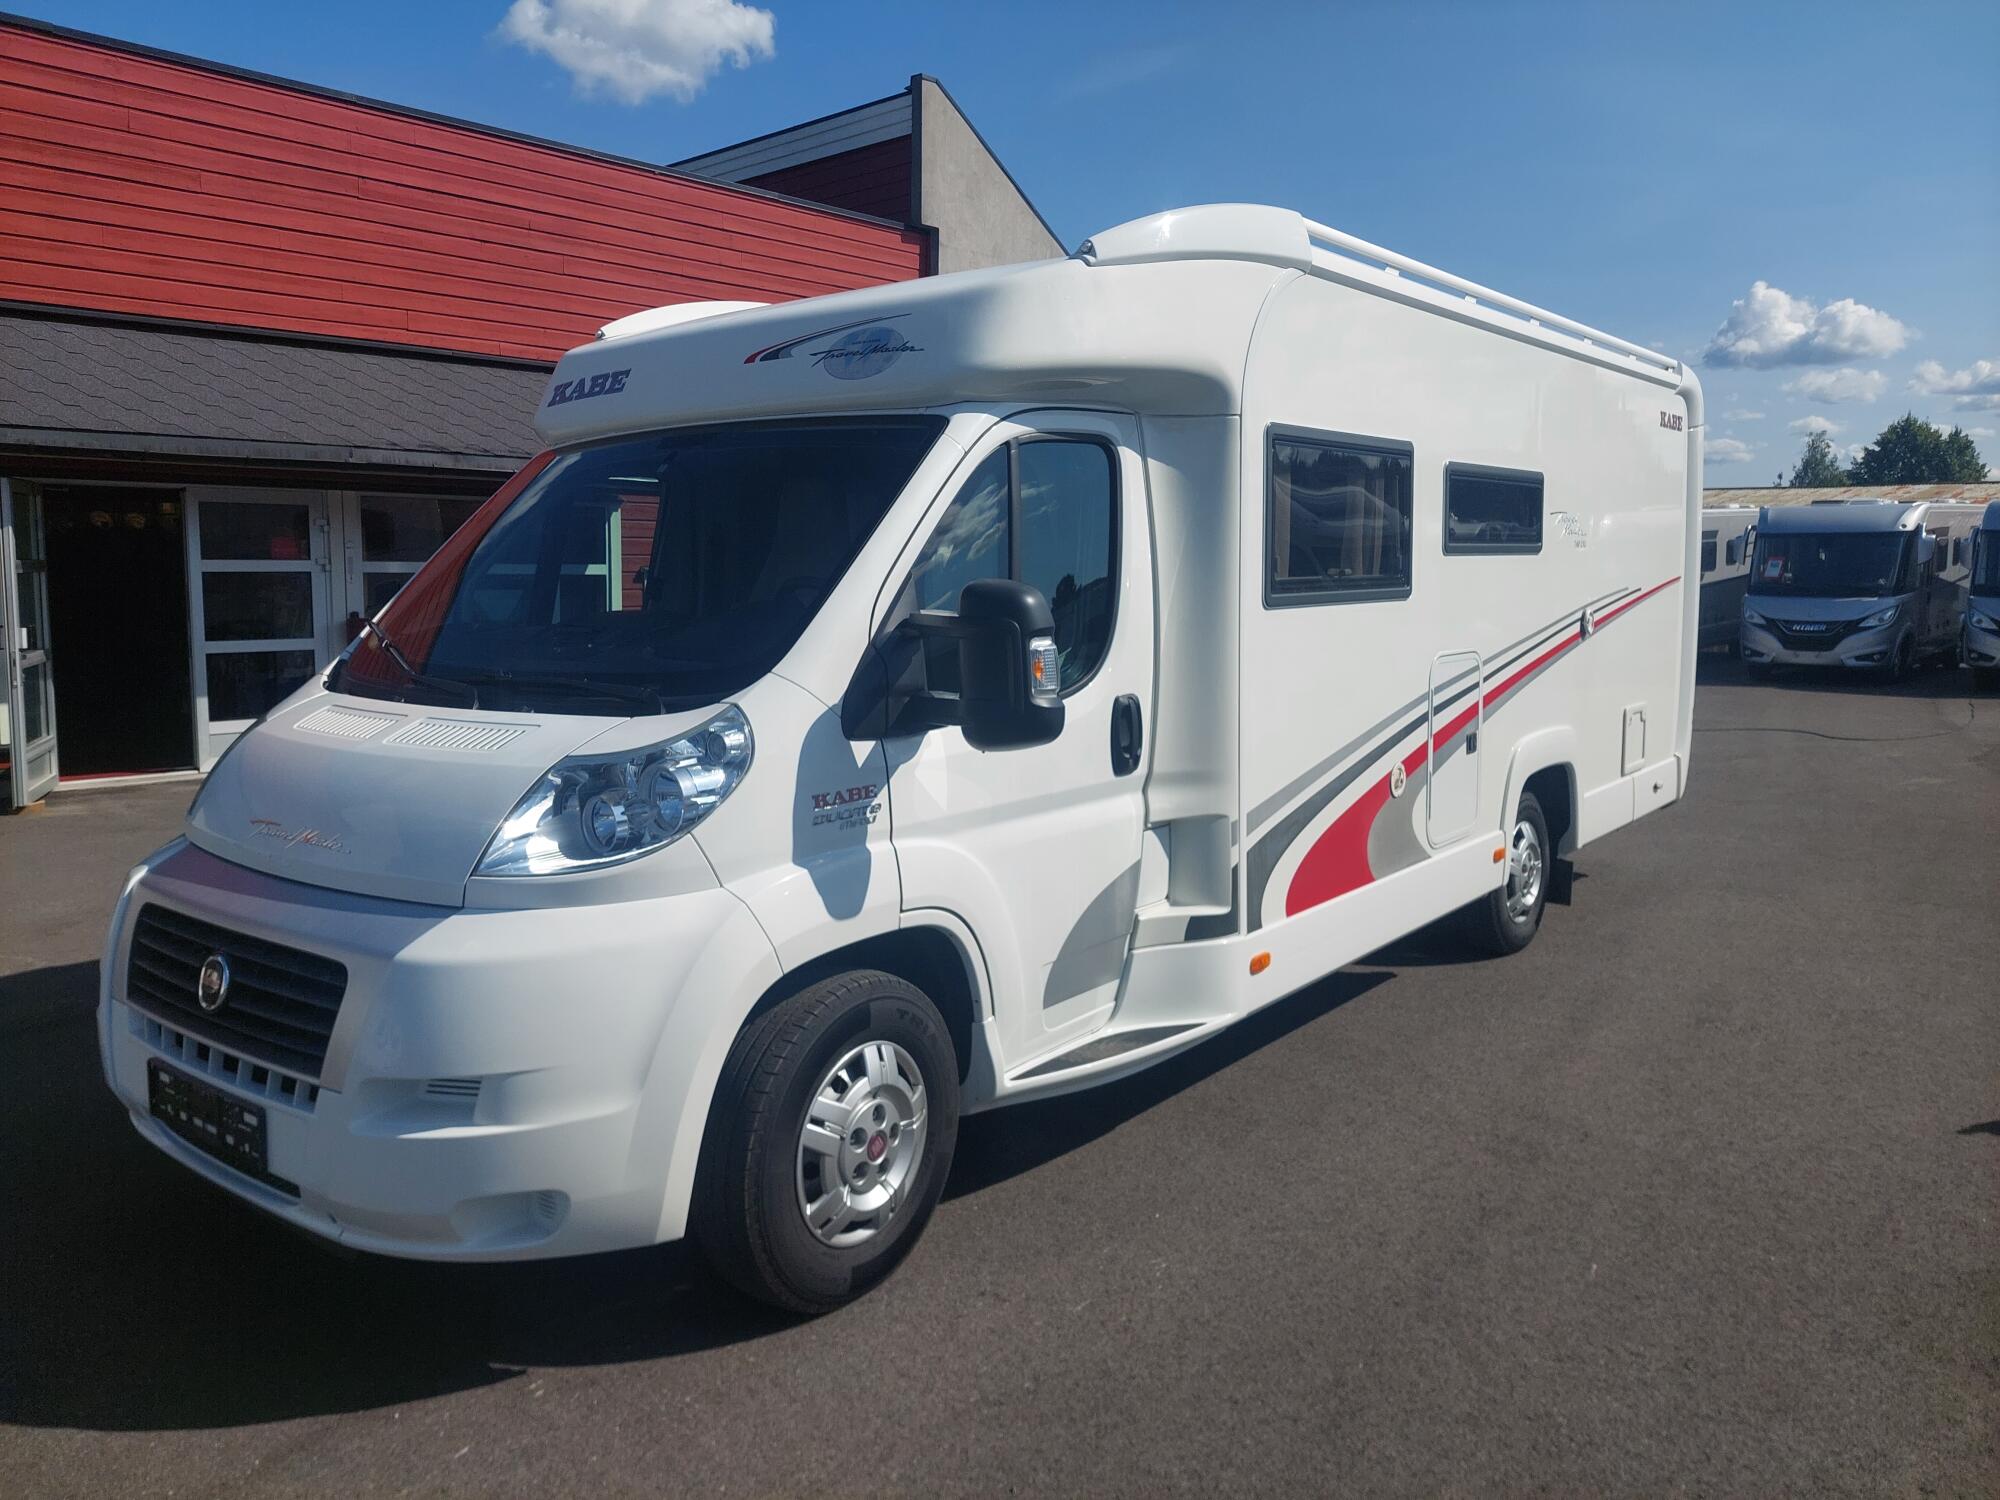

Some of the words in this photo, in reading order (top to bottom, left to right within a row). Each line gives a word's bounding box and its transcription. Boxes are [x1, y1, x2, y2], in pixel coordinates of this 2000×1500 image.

[547, 368, 632, 407] KABE
[1660, 410, 1683, 432] KABE
[811, 784, 878, 811] KABE
